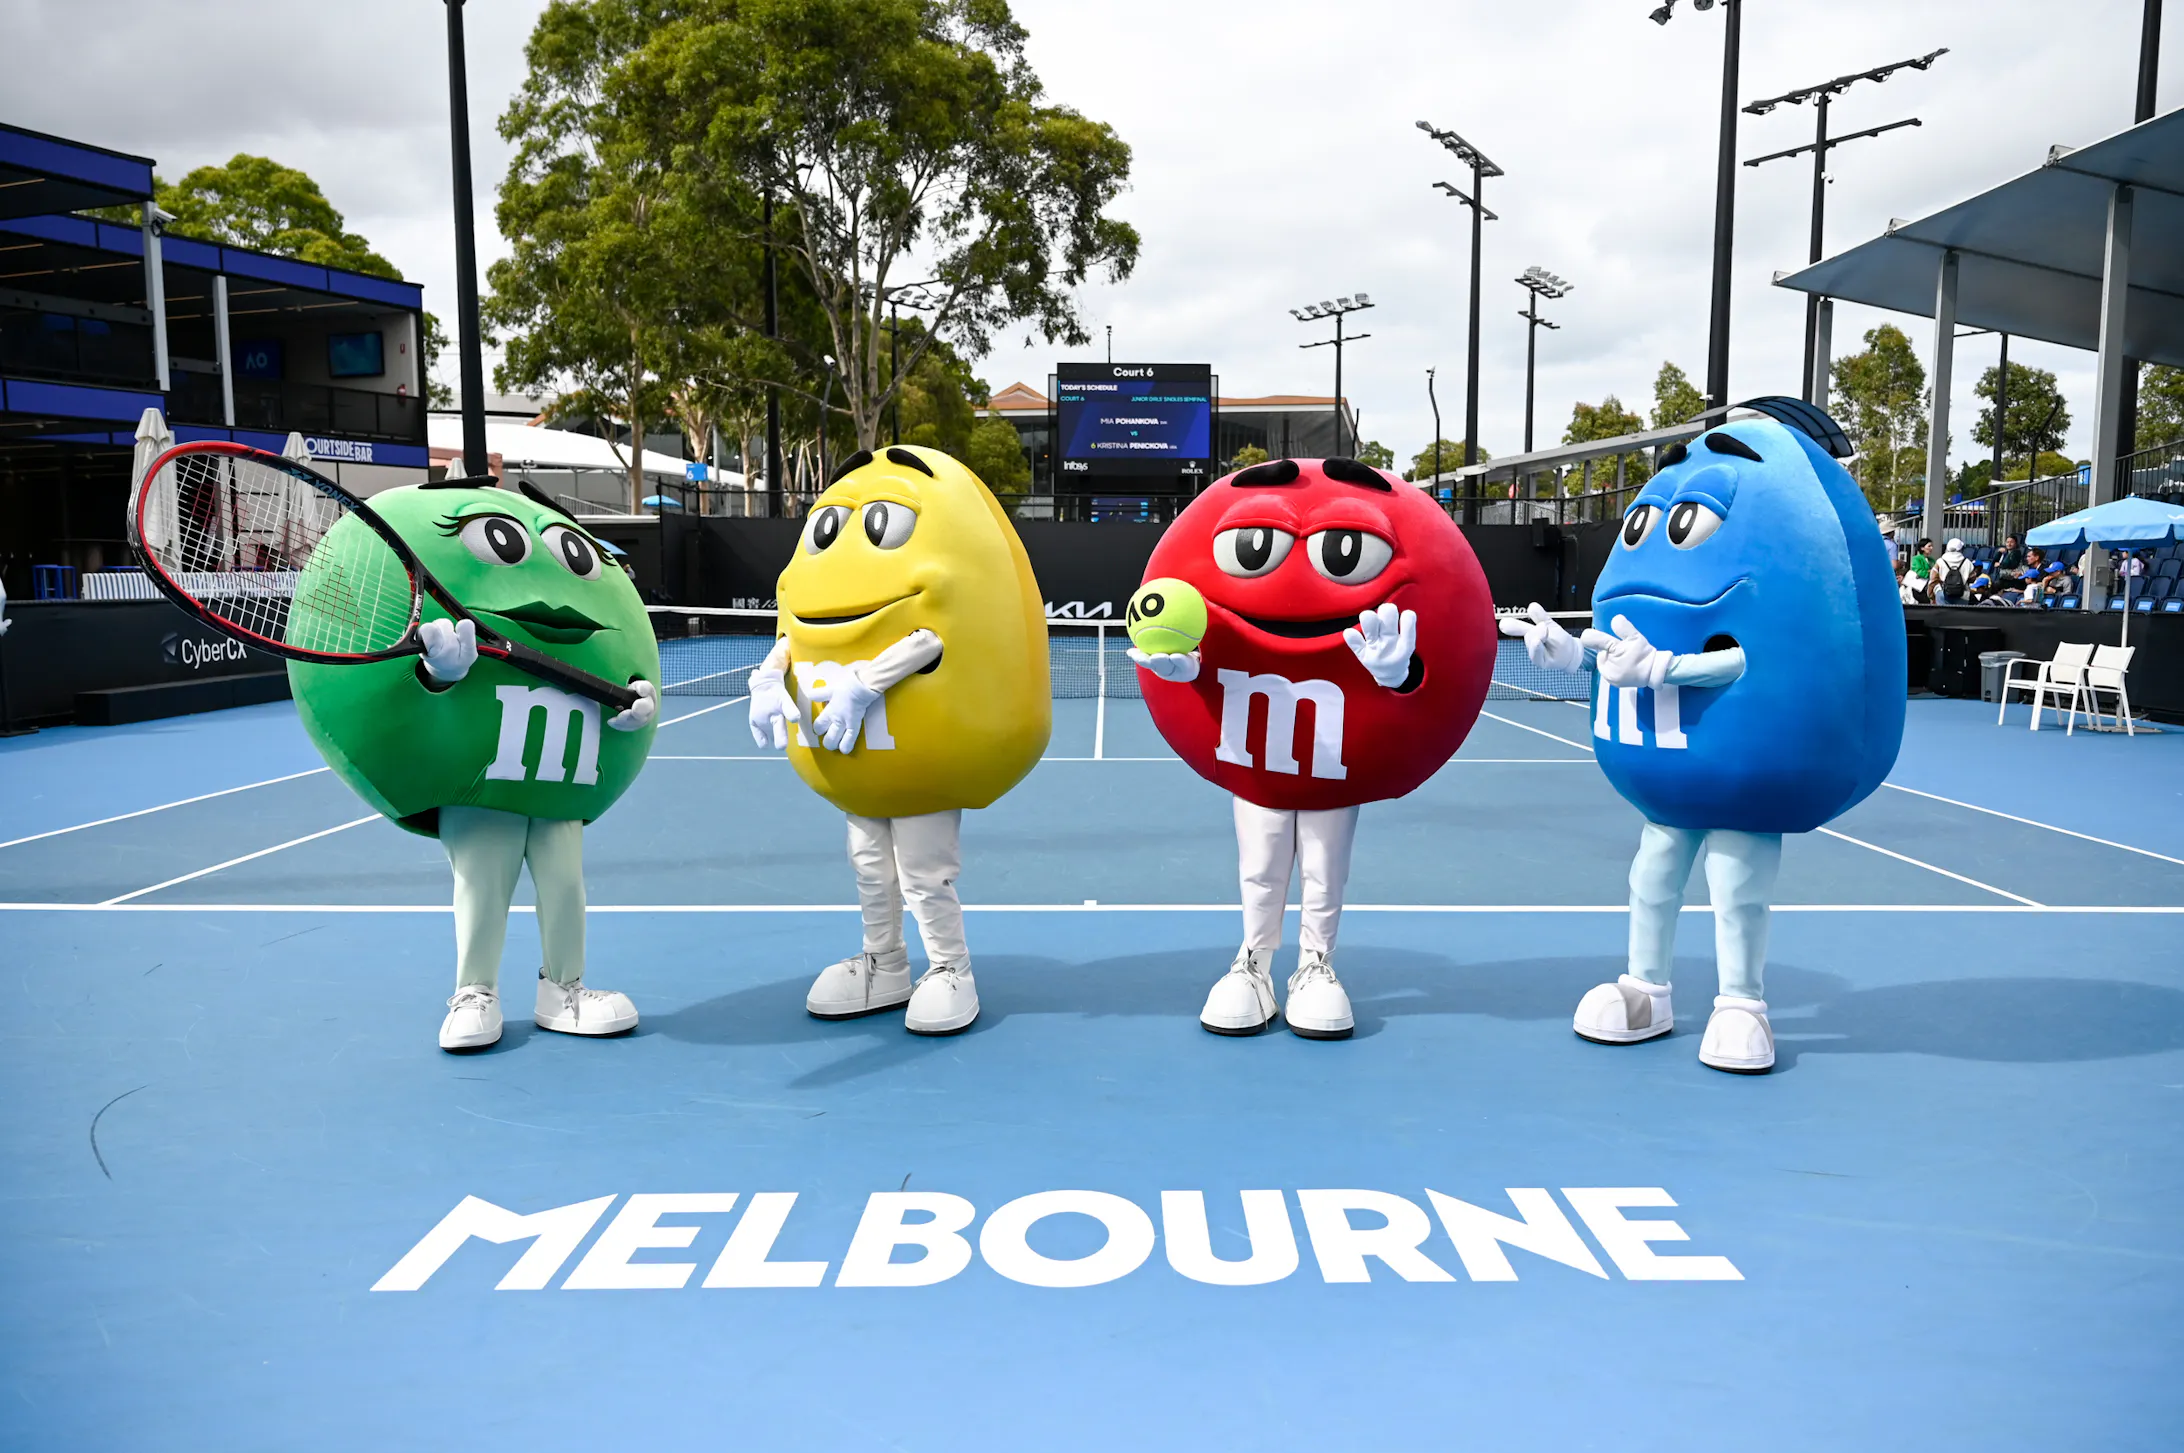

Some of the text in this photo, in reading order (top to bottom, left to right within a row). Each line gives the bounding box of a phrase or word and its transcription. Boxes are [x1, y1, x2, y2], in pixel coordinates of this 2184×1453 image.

[1113, 367, 1154, 377] Court 6
[304, 437, 373, 462] OURTSIDE BAR
[687, 470, 694, 480] 6
[1064, 461, 1089, 471] Infosys
[313, 479, 360, 513] YONEX
[181, 637, 248, 669] CyberCX
[485, 685, 601, 786] m
[1214, 668, 1347, 780] m
[371, 1188, 1745, 1292] MELBOURNE
